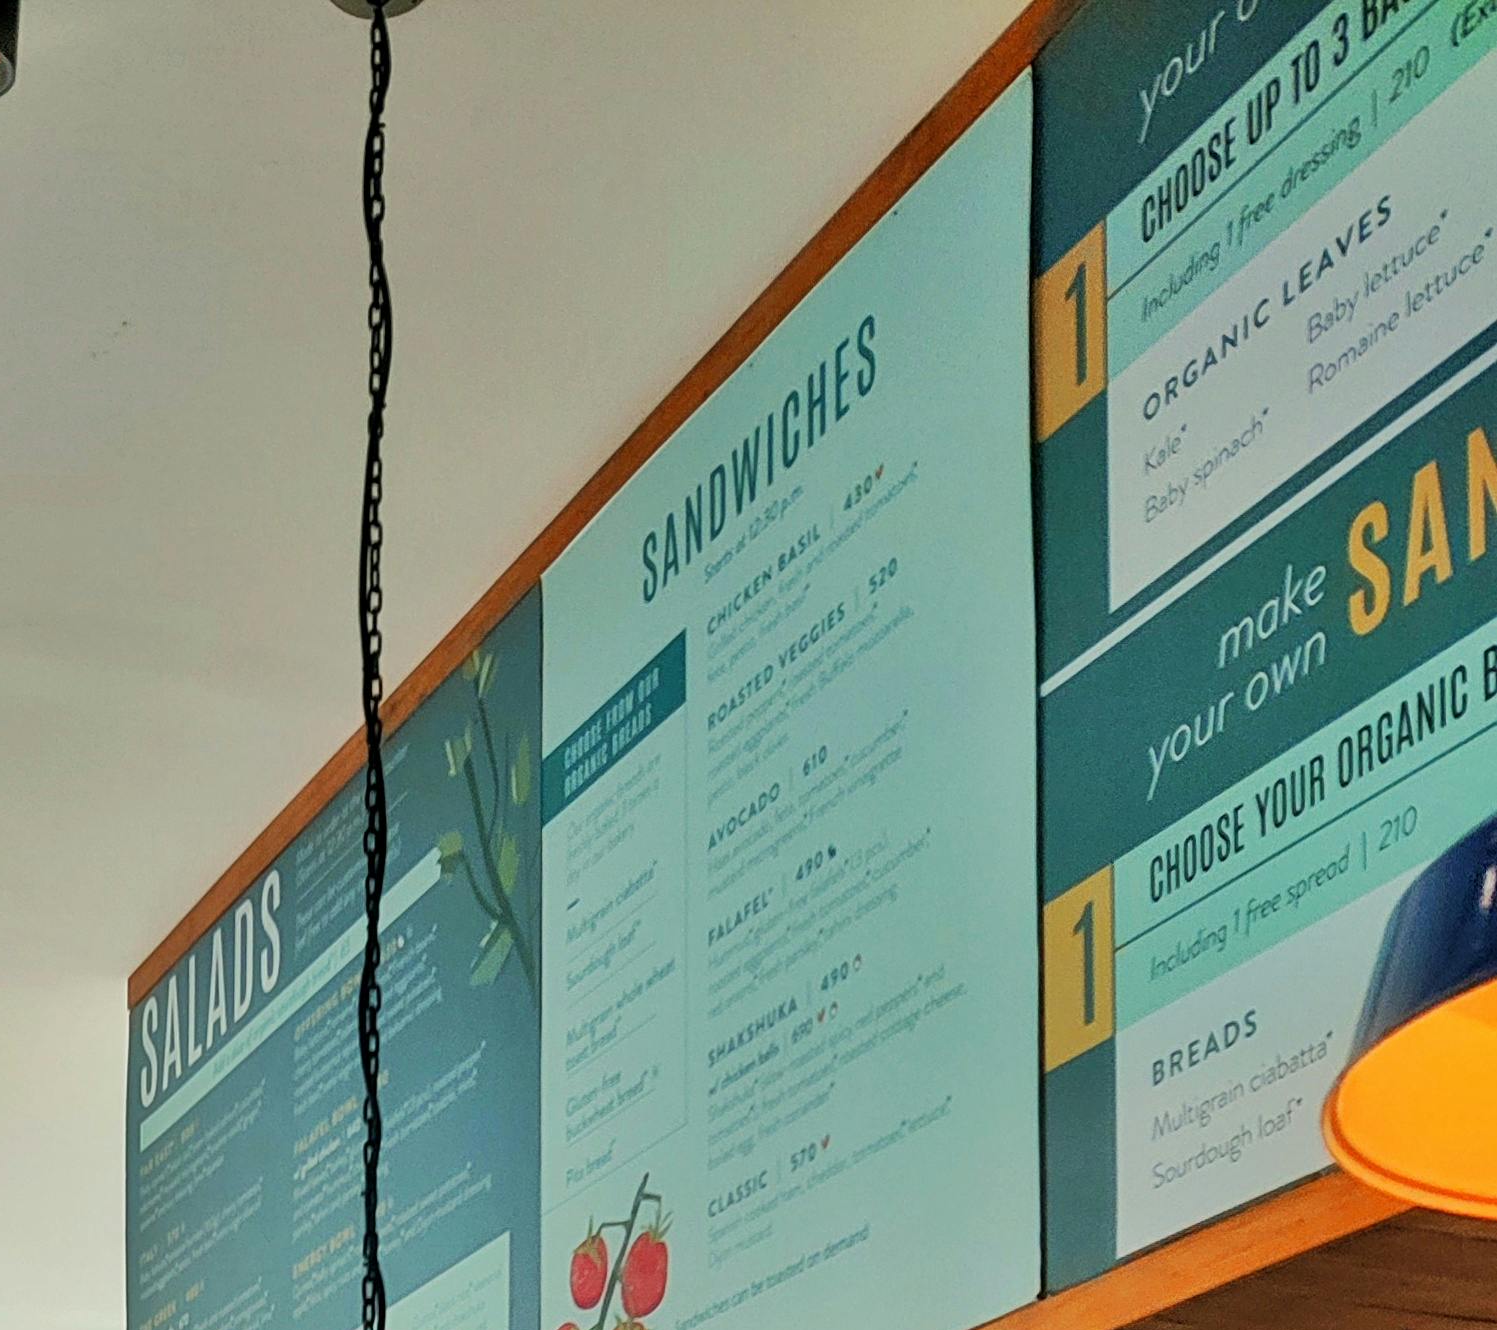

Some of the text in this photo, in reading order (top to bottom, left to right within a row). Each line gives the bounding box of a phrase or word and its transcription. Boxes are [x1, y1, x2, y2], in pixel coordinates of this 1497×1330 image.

[1139, 10, 1224, 142] your
[1141, 118, 1235, 241] CHOOSE
[1247, 77, 1280, 144] UP
[1292, 39, 1320, 103] TO
[1332, 12, 1349, 66] 3
[1141, 241, 1220, 321] Including
[1237, 192, 1274, 245] free
[1280, 116, 1361, 198] dressing
[1388, 45, 1429, 103] 210
[1065, 263, 1086, 385] 1
[1143, 195, 1390, 420] ORGANIC LEAVES
[1307, 291, 1358, 343] Baby
[1308, 311, 1399, 392] Romaine
[643, 318, 874, 600] SANDWICHES
[1144, 478, 1188, 523] Baby
[706, 566, 772, 635] CHICKEN
[777, 525, 820, 572] BASIL
[843, 474, 872, 510] 430
[1218, 565, 1325, 667] make
[707, 664, 773, 730] ROASTED
[778, 602, 844, 668] VEGGIES
[868, 557, 897, 594] 520
[1147, 632, 1325, 799] your own
[707, 782, 779, 850] AVOCADO
[802, 744, 827, 776] 610
[1149, 804, 1243, 901] CHOOSE
[1255, 755, 1324, 835] YOUR
[1337, 666, 1467, 786] ORGANIC
[795, 850, 823, 880] 490
[1150, 805, 1417, 980] Including 1 free spread 210
[141, 873, 279, 1104] SALADS
[708, 961, 848, 1067] SHAKSHUKA 490
[1073, 901, 1094, 1025] 1
[1152, 1010, 1256, 1085] BREADS
[1151, 1082, 1244, 1140] Multigrain
[1152, 1124, 1251, 1188] Sourdough
[707, 1142, 816, 1217] CLASSIC 570
